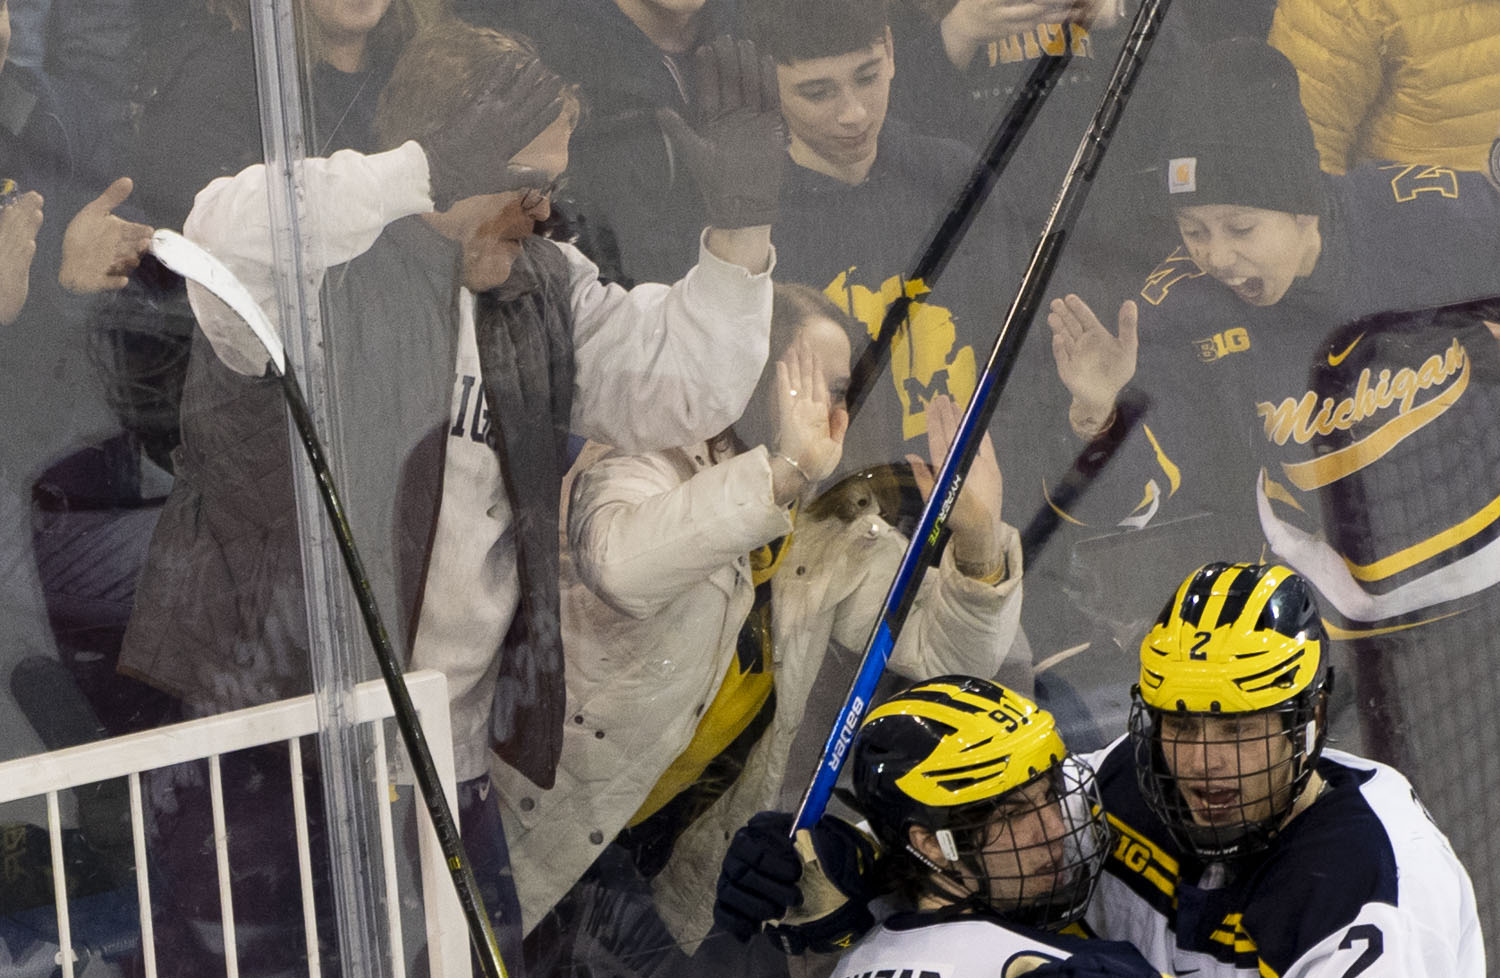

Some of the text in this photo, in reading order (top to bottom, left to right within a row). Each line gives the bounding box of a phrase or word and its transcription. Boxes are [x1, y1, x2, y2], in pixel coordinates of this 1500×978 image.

[1255, 337, 1465, 446] Michigan
[1190, 631, 1212, 660] 2
[828, 696, 865, 772] BAUER
